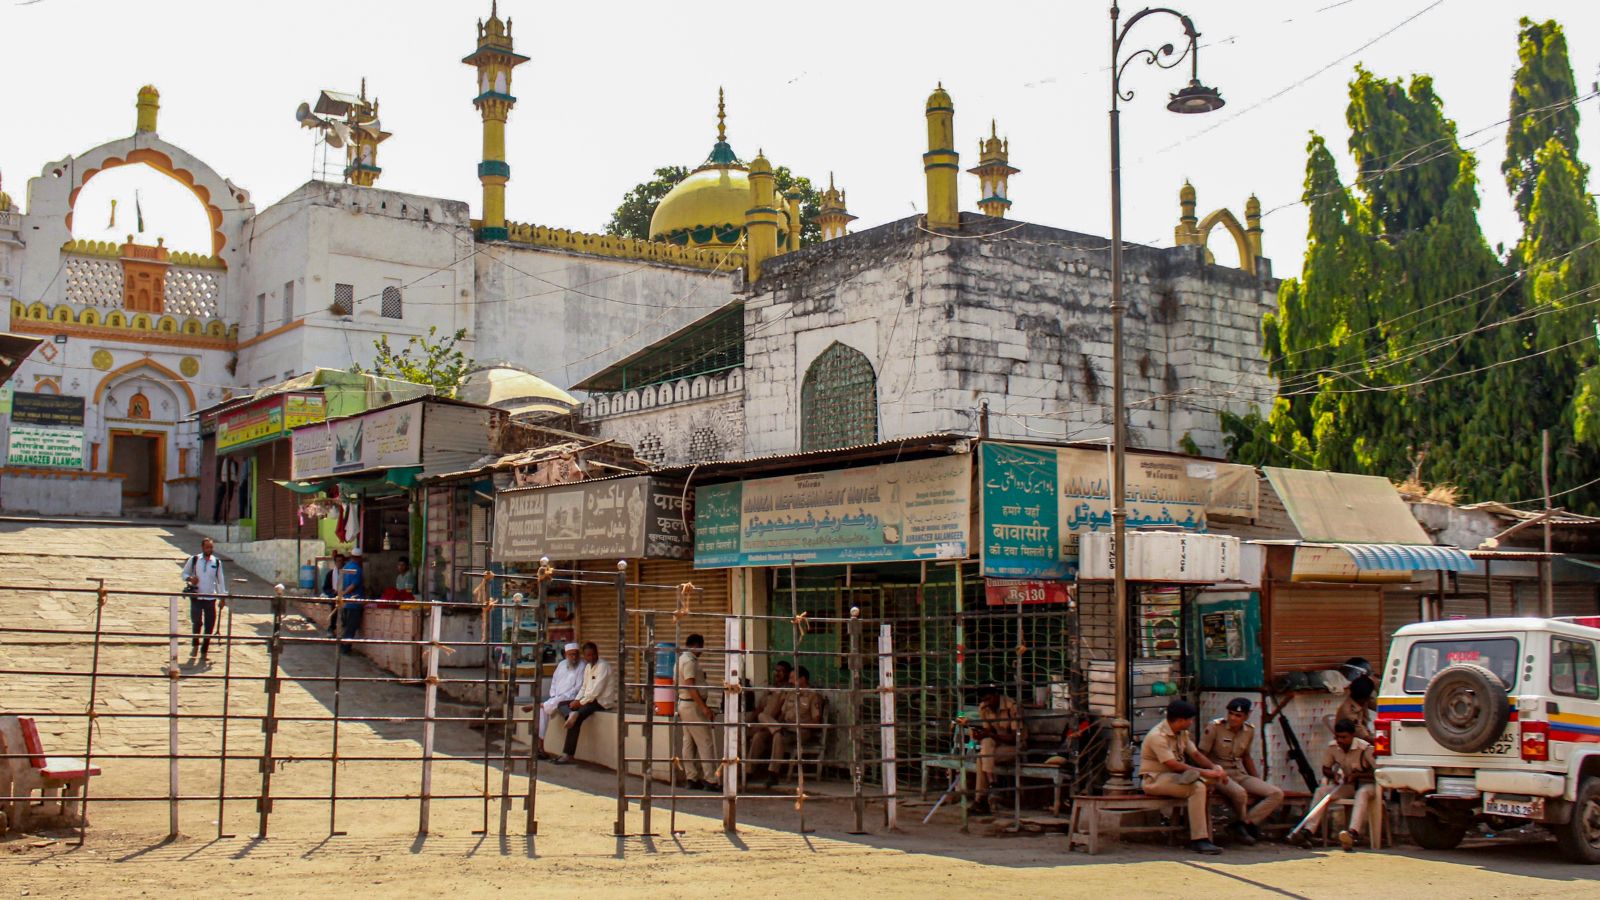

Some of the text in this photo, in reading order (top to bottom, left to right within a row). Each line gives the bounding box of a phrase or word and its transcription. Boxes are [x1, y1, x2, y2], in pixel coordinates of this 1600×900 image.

[10, 454, 50, 465] AURANGZEB
[1145, 471, 1179, 481] Welcome
[509, 493, 545, 516] PAKEEZA
[992, 520, 1050, 542] बावासीर
[1010, 589, 1046, 602] Rs130
[1446, 652, 1481, 661] POLICE
